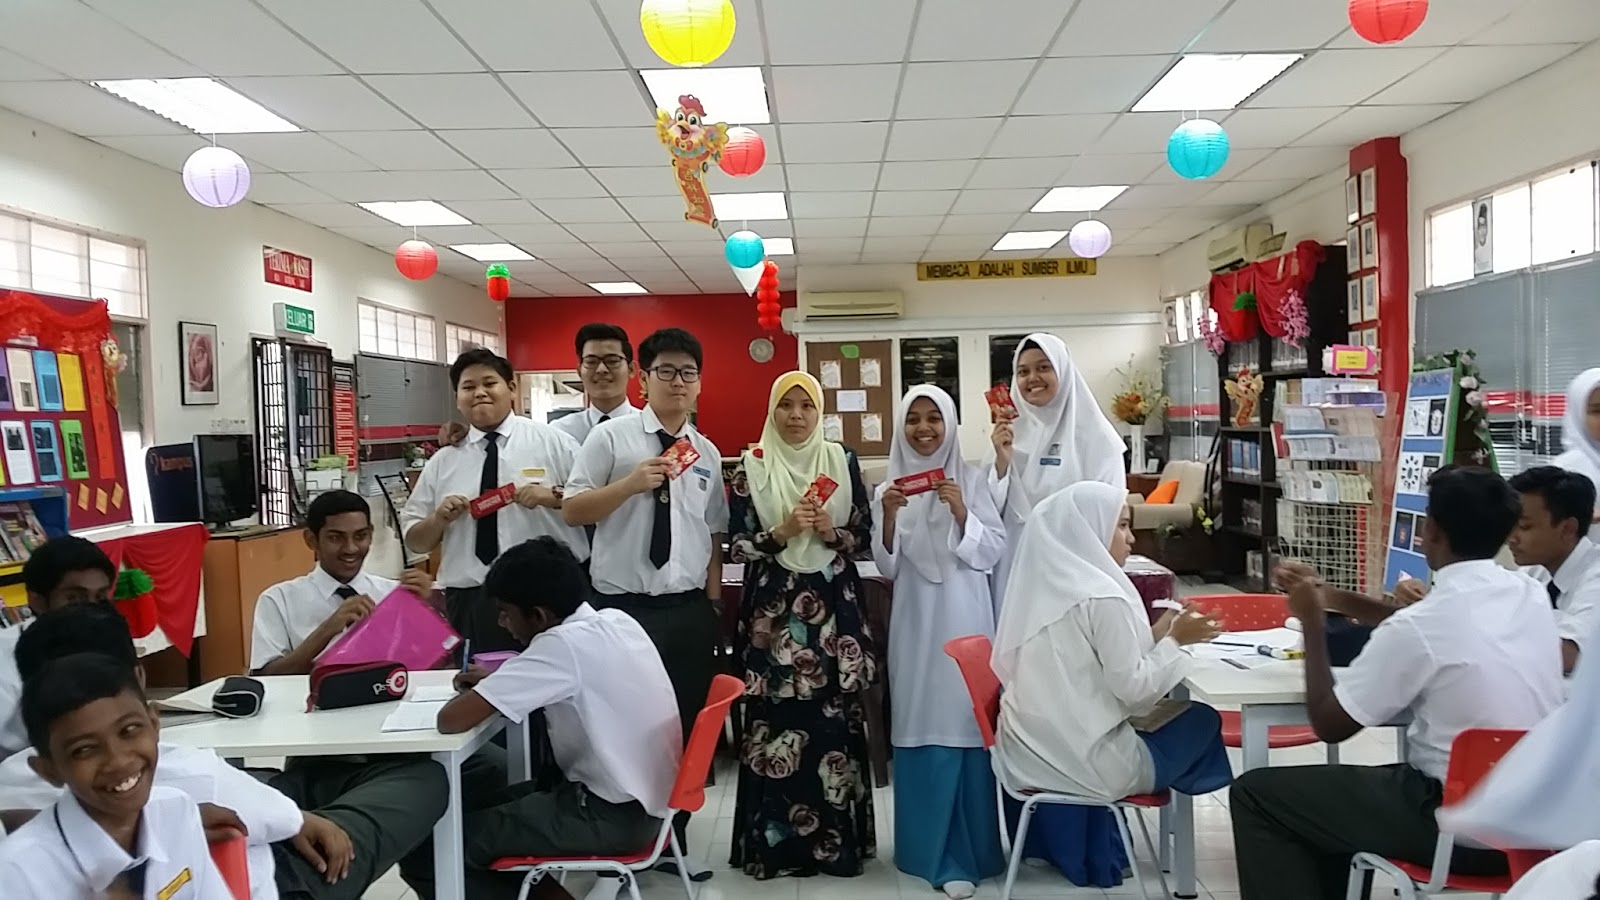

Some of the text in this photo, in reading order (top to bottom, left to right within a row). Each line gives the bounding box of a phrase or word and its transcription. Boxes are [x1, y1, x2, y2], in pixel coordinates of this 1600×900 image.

[926, 260, 1088, 279] MEMBACA ADALAH SUMBER ILMU
